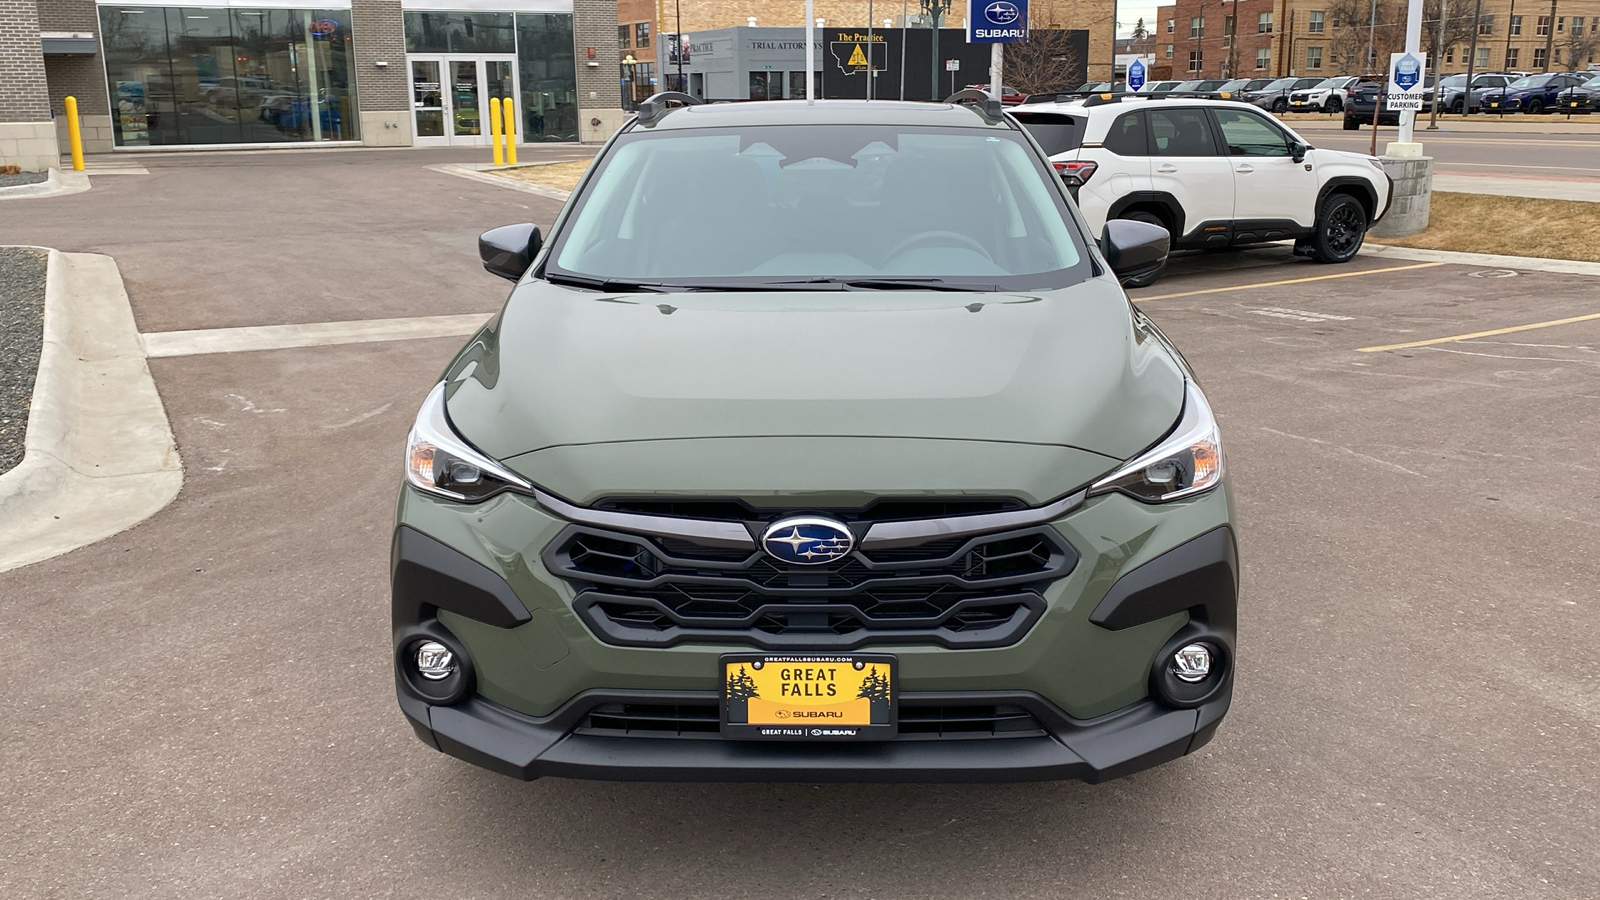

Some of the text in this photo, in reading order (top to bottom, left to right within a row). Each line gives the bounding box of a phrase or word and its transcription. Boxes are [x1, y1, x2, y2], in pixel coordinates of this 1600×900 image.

[838, 33, 852, 42] The
[976, 29, 1025, 38] SUBARU
[752, 42, 776, 50] TRIAL
[780, 668, 837, 681] GREAT
[780, 683, 837, 696] FALLS
